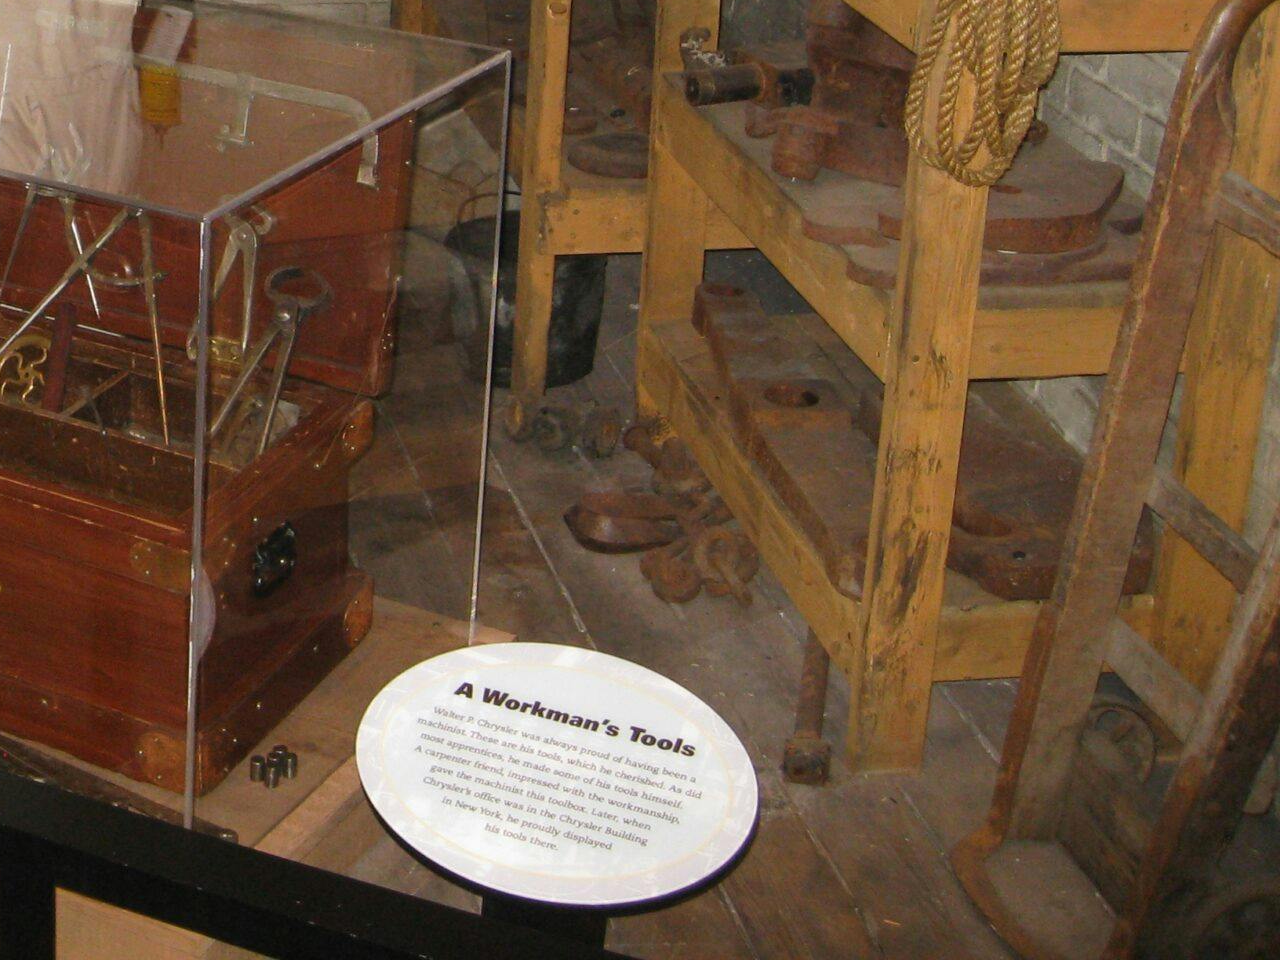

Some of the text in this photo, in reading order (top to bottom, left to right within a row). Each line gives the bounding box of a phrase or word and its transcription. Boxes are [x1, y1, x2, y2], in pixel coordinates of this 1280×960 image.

[434, 706, 465, 721] Walter
[477, 719, 518, 735] Chrysler
[522, 731, 540, 741] was
[543, 737, 578, 751] always
[580, 746, 610, 760] proud
[613, 754, 623, 763] of
[624, 757, 660, 775] having
[662, 767, 687, 781] been
[454, 682, 696, 757] A Workman's Tools
[414, 745, 422, 753] A
[425, 748, 472, 766] carpenter
[507, 769, 560, 790] impressed
[562, 785, 585, 798] with
[588, 792, 605, 802] the
[420, 733, 444, 744] most
[508, 754, 520, 765] he
[522, 760, 551, 773] made
[553, 769, 580, 780] some
[595, 779, 610, 790] his
[614, 784, 638, 797] tools
[470, 730, 499, 744] These
[501, 741, 517, 750] are
[520, 744, 534, 754] his
[567, 758, 596, 771] which
[599, 766, 612, 775] he
[668, 784, 682, 794] As
[685, 789, 702, 800] did
[430, 765, 453, 776] gave
[456, 769, 472, 780] the
[474, 776, 523, 796] machinist
[526, 788, 545, 801] this
[622, 816, 651, 831] when
[442, 796, 453, 805] in
[455, 800, 477, 812] New
[506, 814, 520, 824] he
[521, 820, 560, 836] proudly
[562, 830, 613, 850] displayed
[474, 791, 502, 804] office
[504, 799, 523, 810] was
[526, 804, 537, 814] in
[539, 808, 557, 819] the
[559, 814, 602, 832] Chrysler
[604, 826, 648, 847] Building
[484, 823, 499, 834] his
[502, 828, 527, 841] tools
